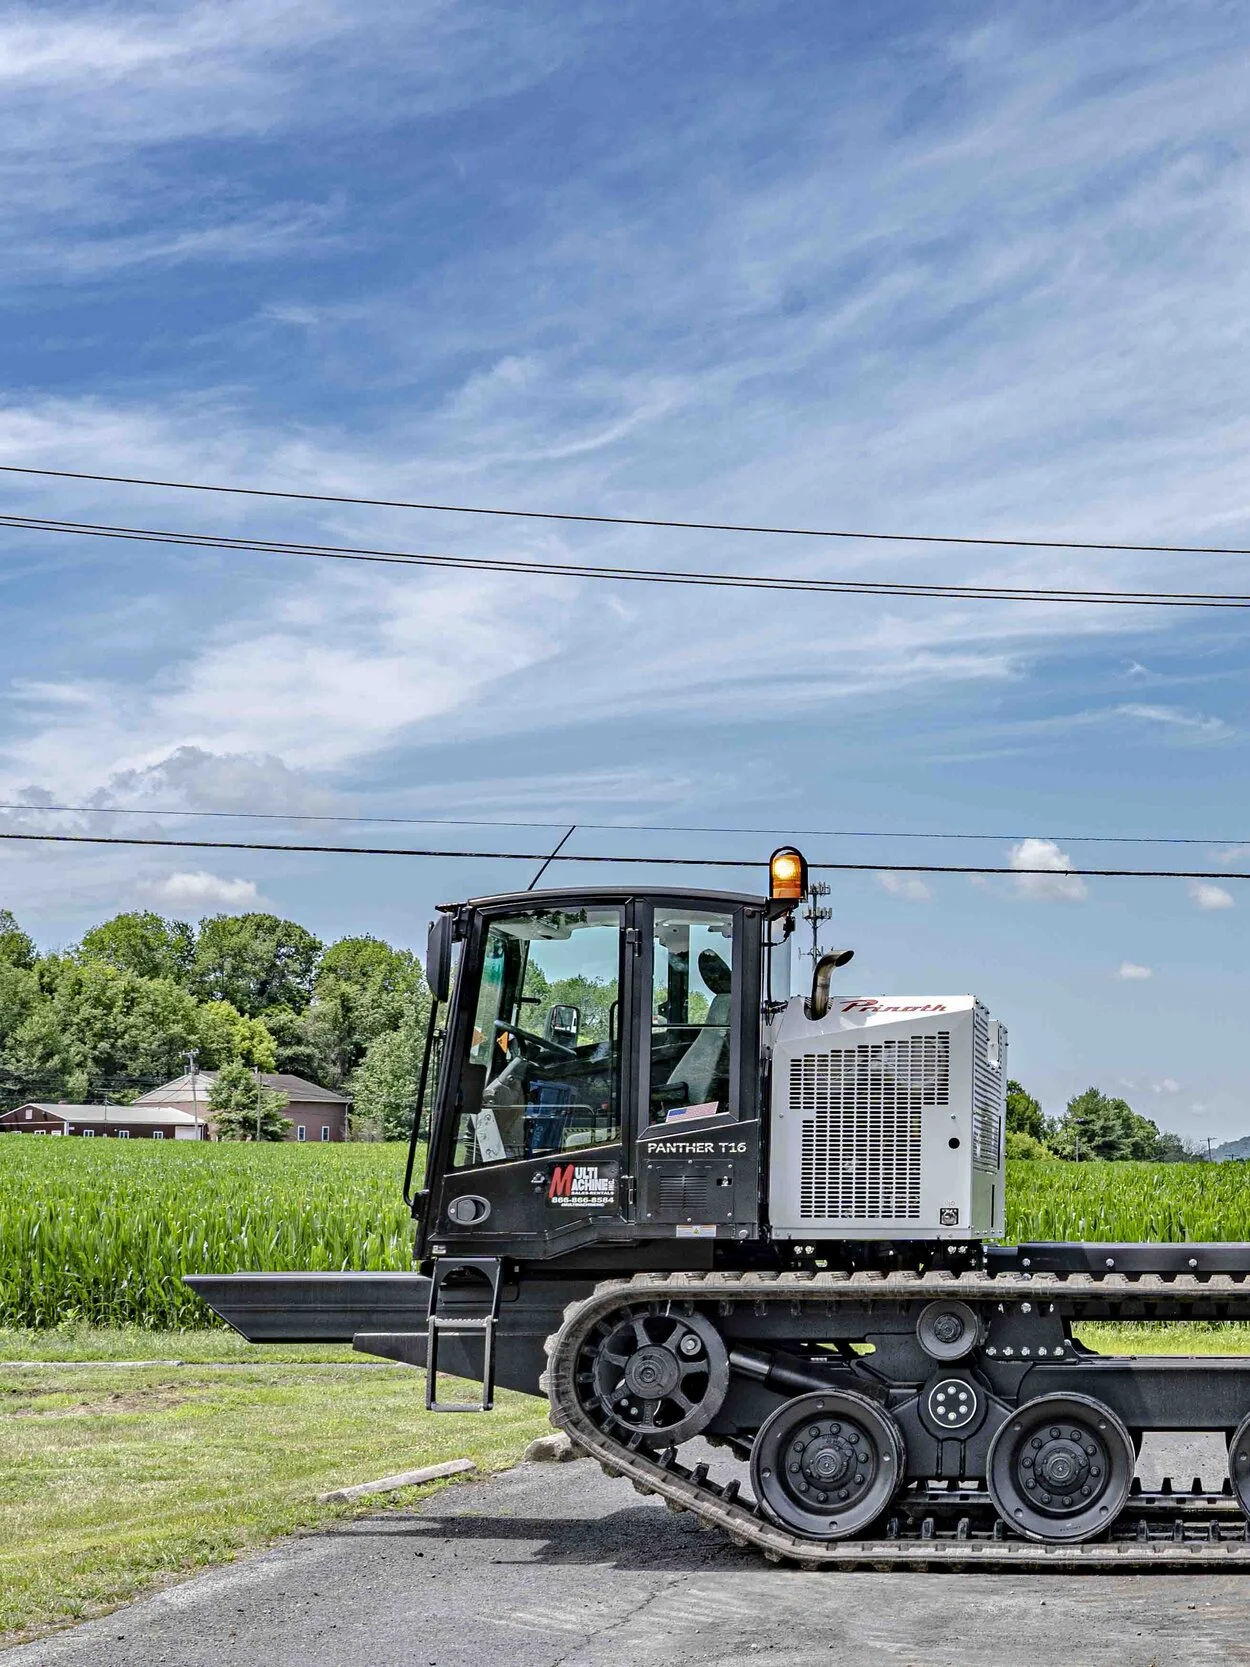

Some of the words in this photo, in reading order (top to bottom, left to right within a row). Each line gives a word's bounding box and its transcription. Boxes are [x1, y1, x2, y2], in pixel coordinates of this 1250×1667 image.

[840, 999, 947, 1012] Prinoth
[647, 1142, 714, 1153] PANTHER
[718, 1142, 747, 1153] T16
[551, 1196, 615, 1204] 866-866-8584
